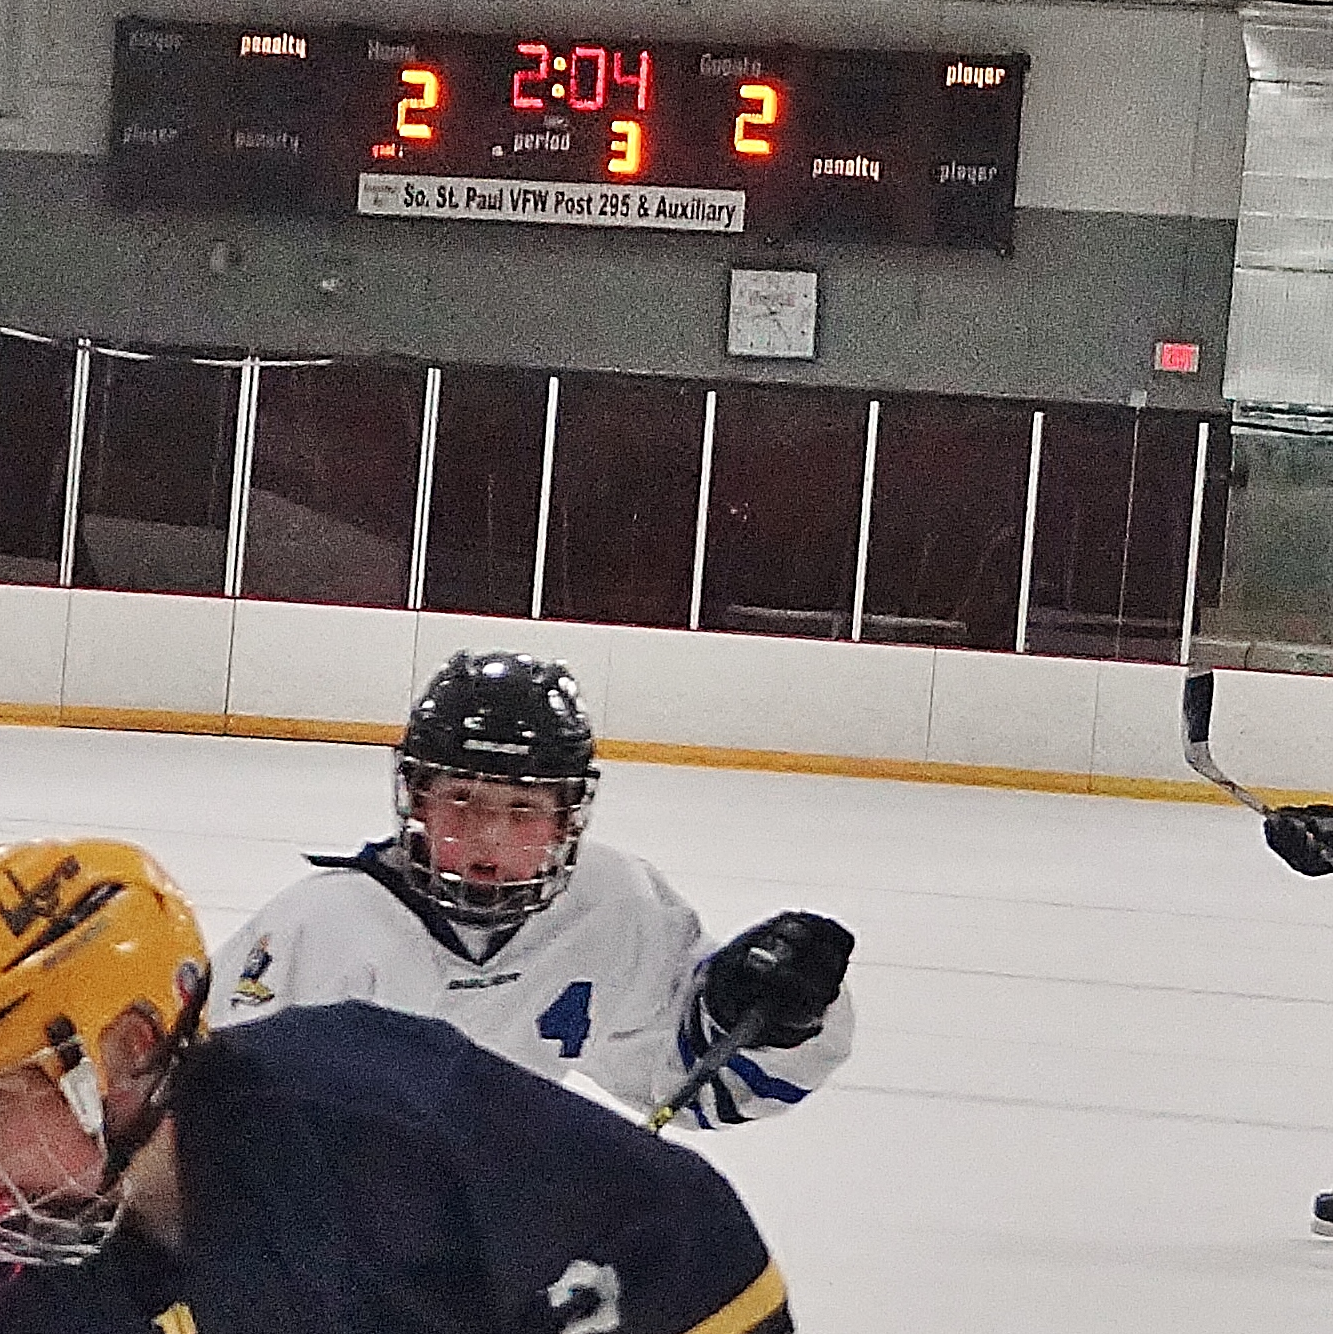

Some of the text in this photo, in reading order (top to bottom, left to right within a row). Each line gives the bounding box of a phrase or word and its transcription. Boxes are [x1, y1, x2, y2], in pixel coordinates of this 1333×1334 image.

[239, 33, 307, 59] penalty
[512, 41, 652, 111] 2:04
[946, 62, 1006, 87] player
[396, 69, 438, 140] 2
[734, 84, 777, 155] 2
[513, 130, 571, 153] period
[607, 120, 642, 175] 3
[812, 153, 882, 182] penalty
[939, 160, 999, 185] player
[403, 183, 430, 208] So.
[465, 186, 504, 211] Paul
[510, 188, 550, 214] VFW
[554, 191, 594, 216] Post
[598, 194, 631, 218] 295
[637, 194, 650, 218] &
[654, 194, 737, 229] Auxiliary
[537, 980, 593, 1059] 4
